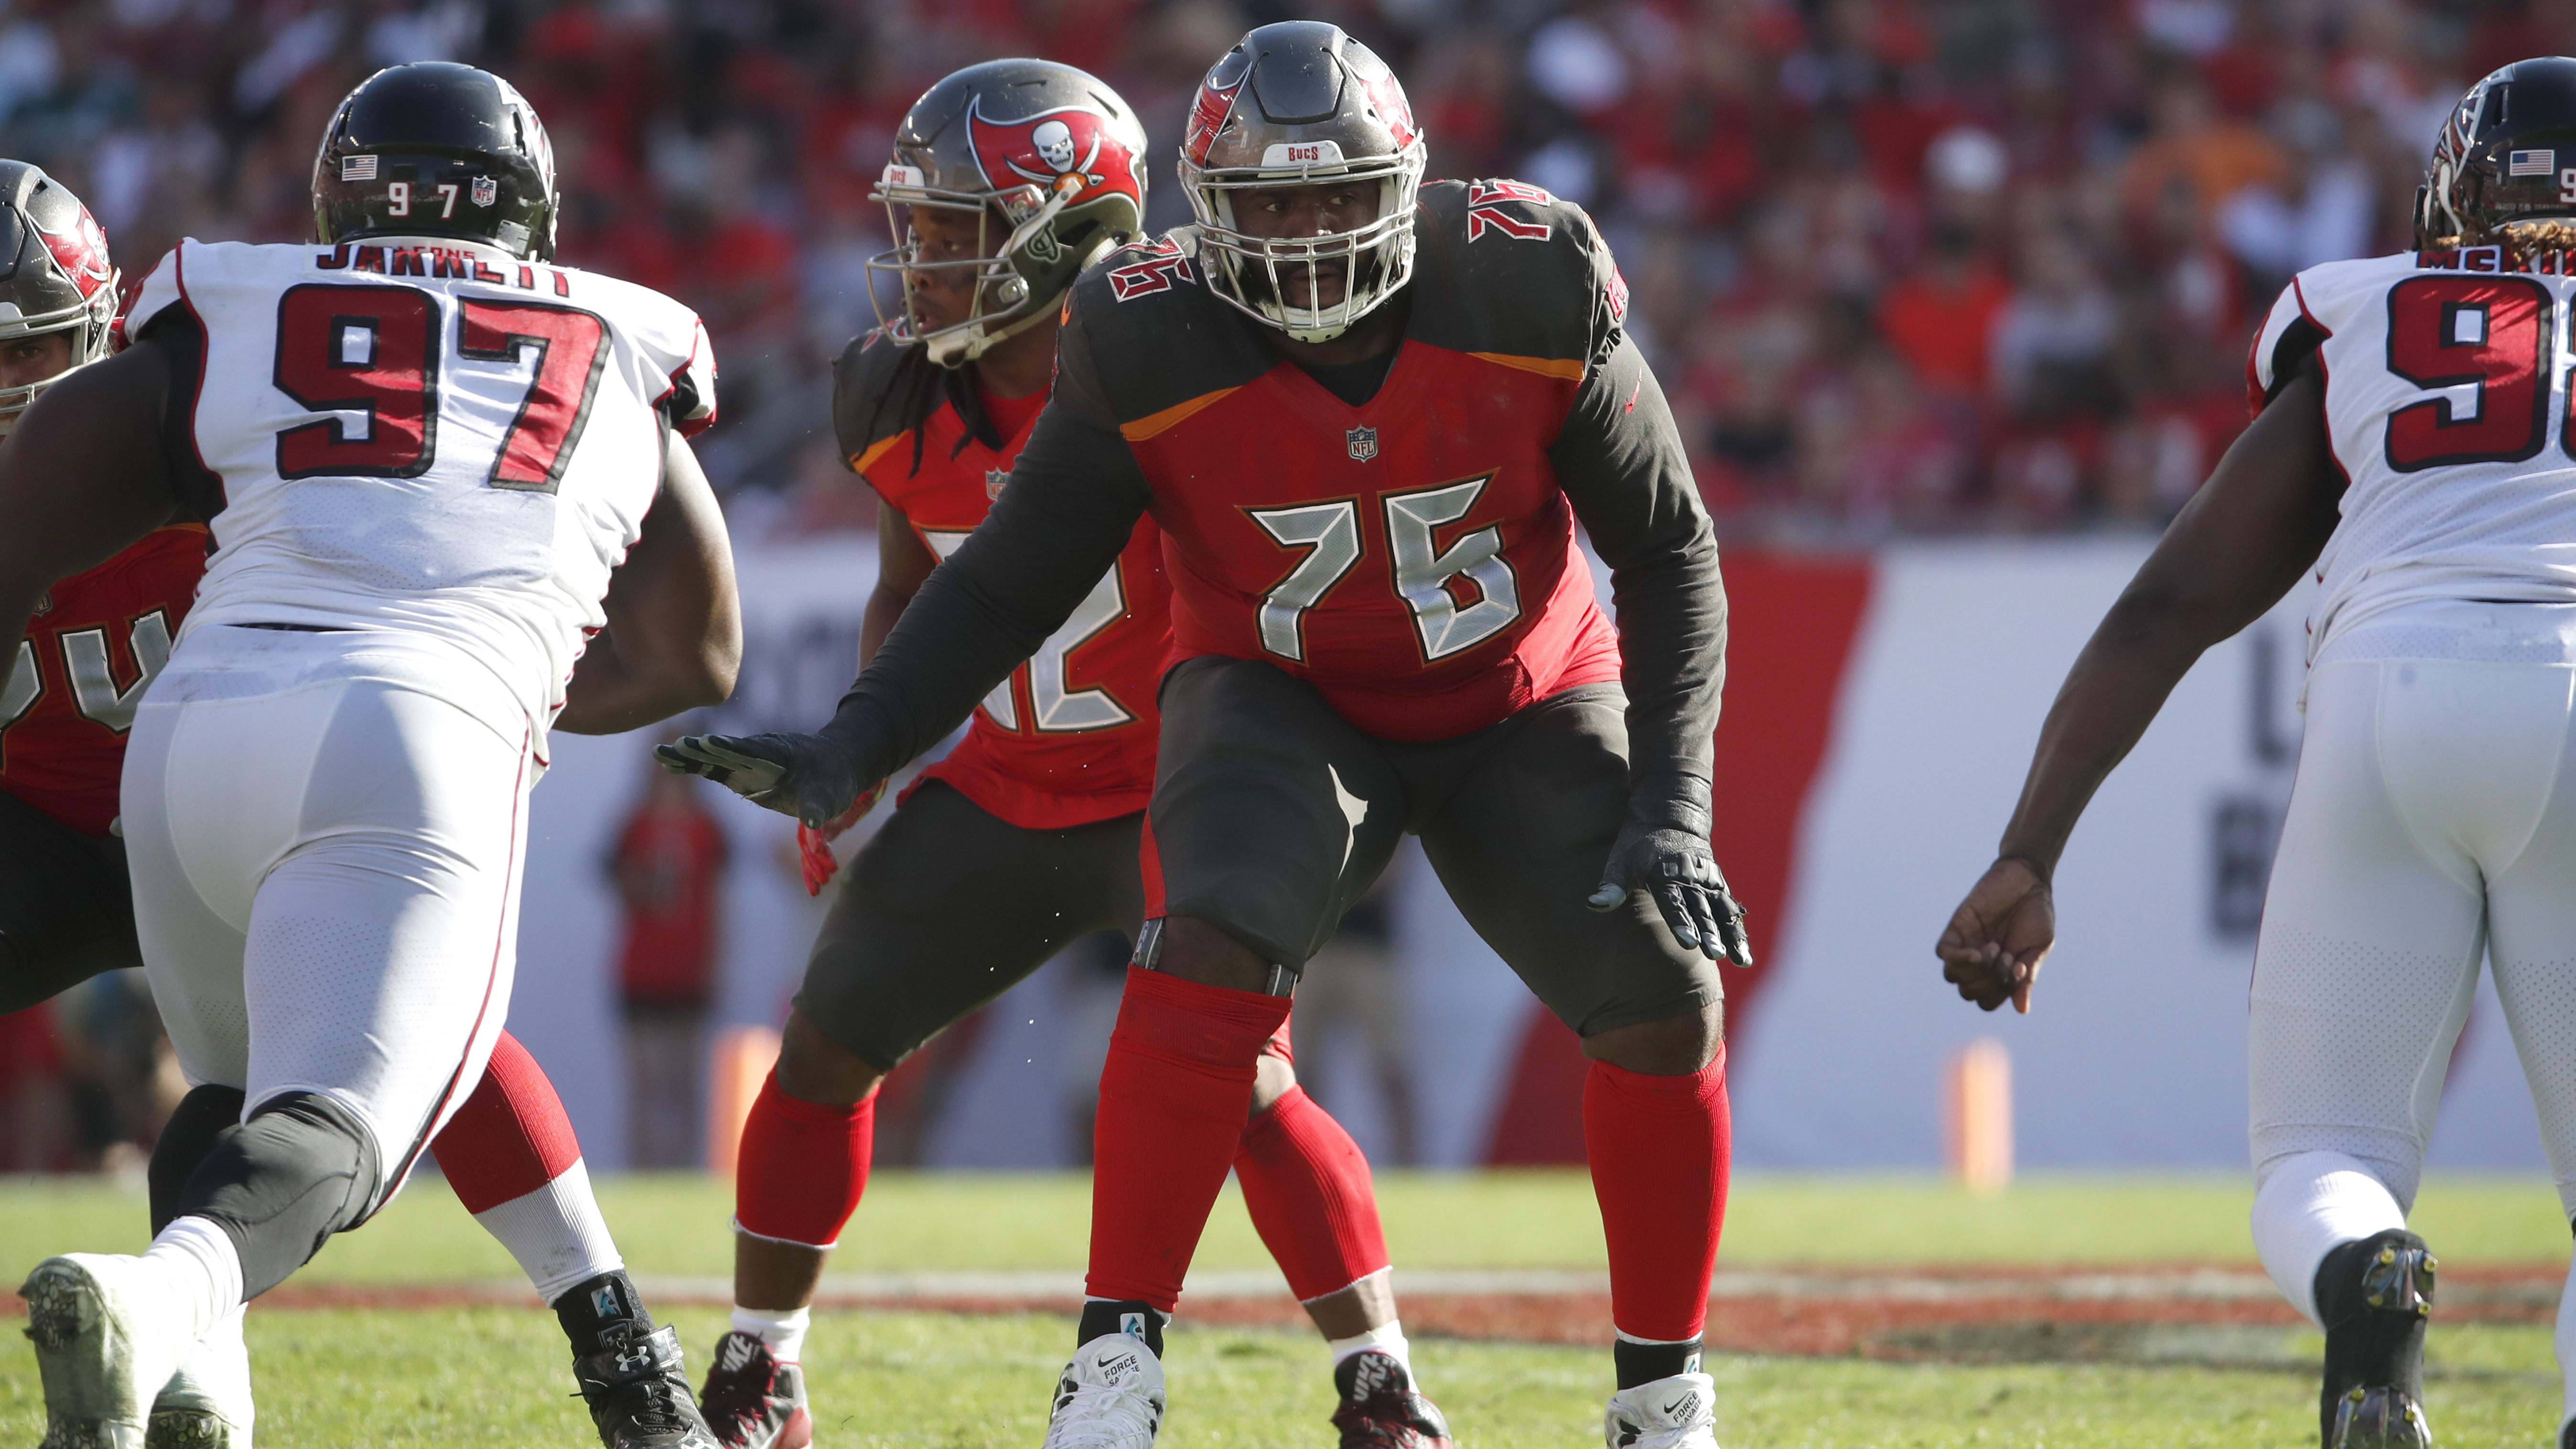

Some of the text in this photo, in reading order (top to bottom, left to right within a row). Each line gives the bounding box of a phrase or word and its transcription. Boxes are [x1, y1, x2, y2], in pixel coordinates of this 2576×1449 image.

[1289, 146, 1318, 161] BUCS
[475, 189, 491, 202] NFL
[2386, 274, 2576, 473] 9
[273, 283, 612, 495] 97
[1352, 442, 1374, 455] NFL
[1235, 466, 1524, 668] 76
[1104, 1355, 1137, 1380] FORCE
[1673, 1391, 1698, 1423] FORCE
